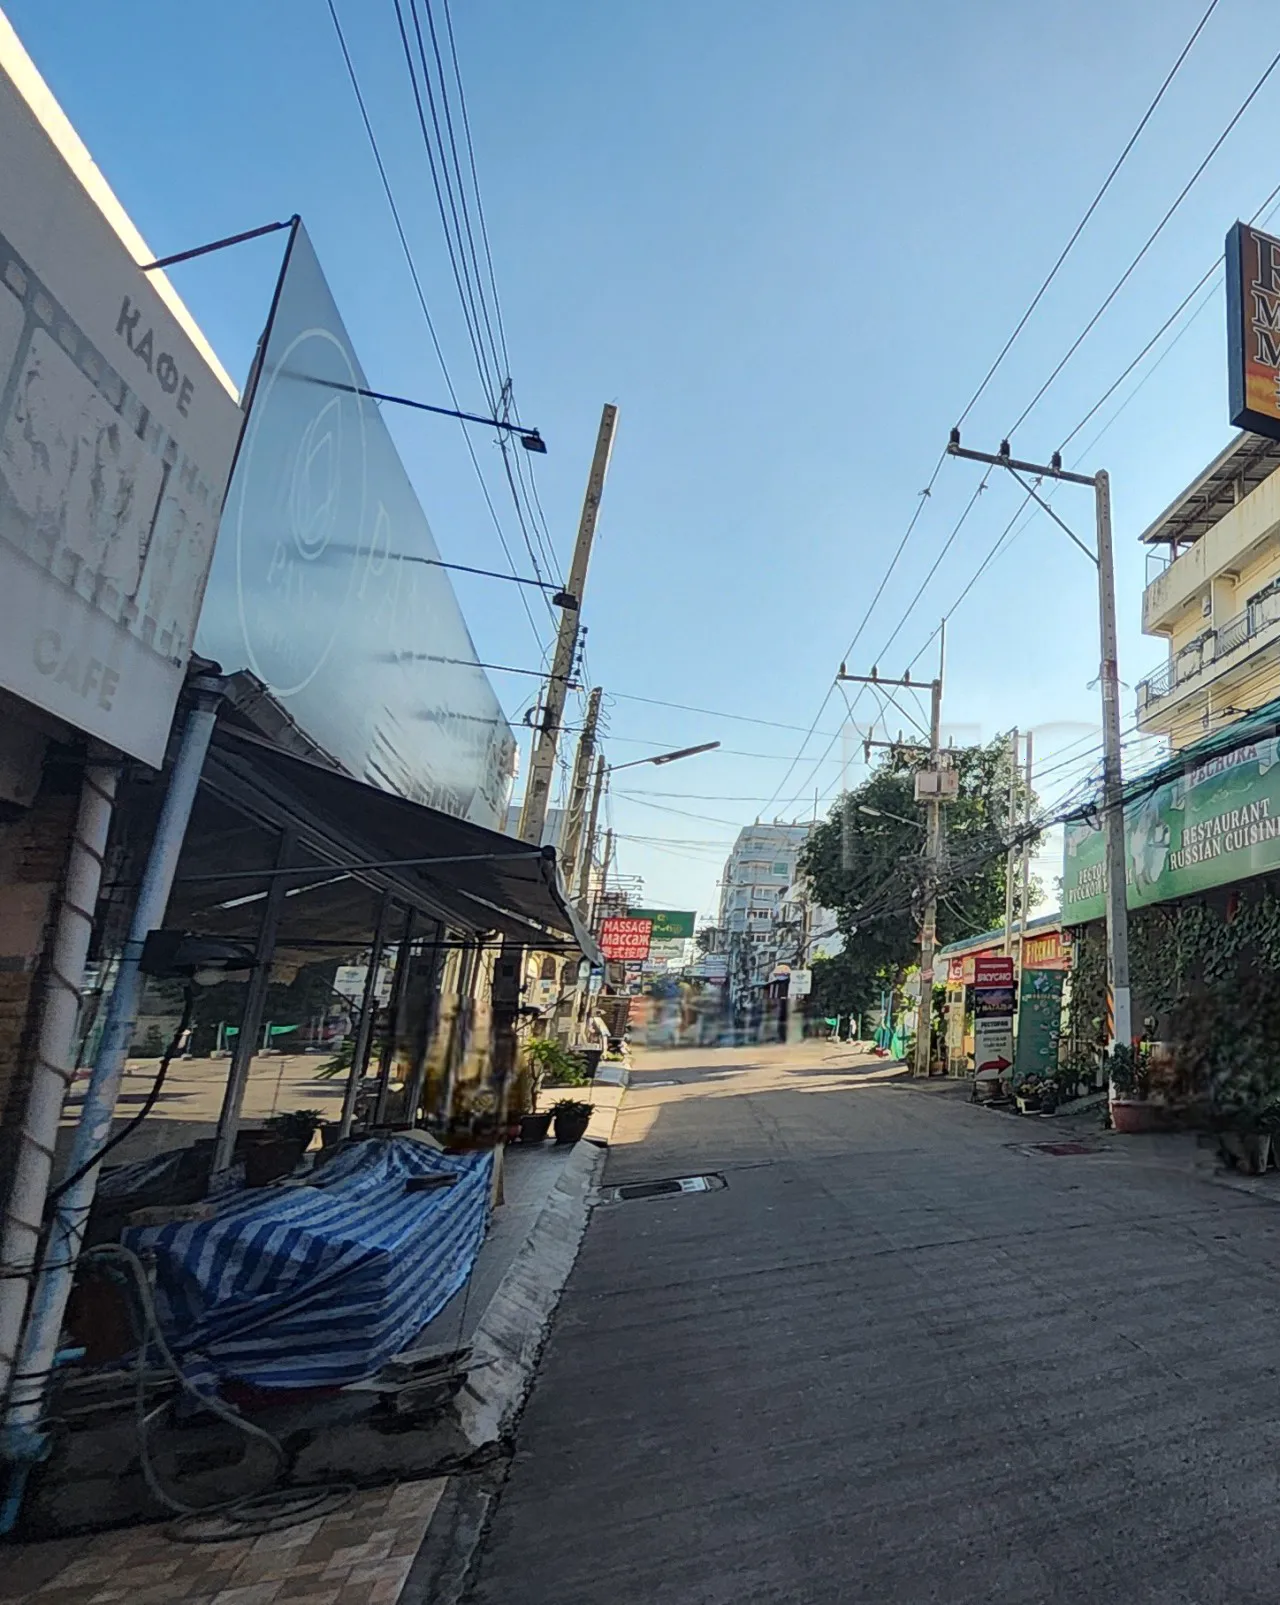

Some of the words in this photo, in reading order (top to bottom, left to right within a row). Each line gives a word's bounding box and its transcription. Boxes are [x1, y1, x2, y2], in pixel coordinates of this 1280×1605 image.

[115, 295, 195, 419] КАФЕ
[33, 629, 120, 713] CAFE
[1181, 797, 1271, 848] RESTAURANT
[1168, 839, 1222, 872] RUSSIAN
[603, 920, 652, 933] MASSAGE
